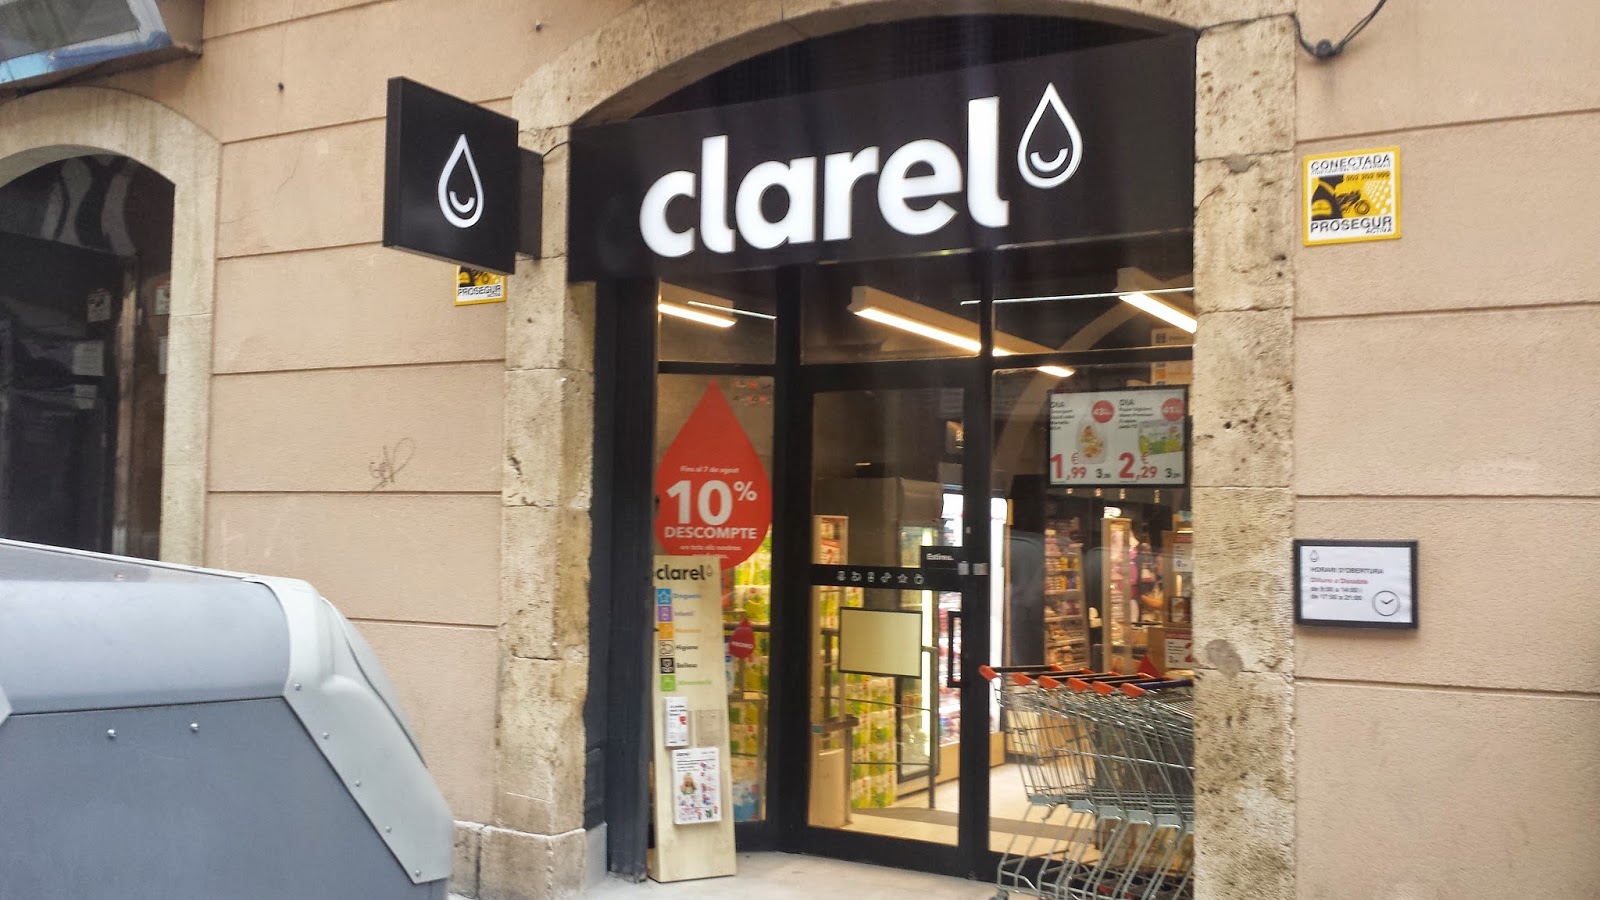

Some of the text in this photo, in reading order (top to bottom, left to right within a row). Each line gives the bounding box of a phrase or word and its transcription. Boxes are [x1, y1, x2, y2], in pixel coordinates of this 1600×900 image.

[1311, 154, 1390, 170] CONECTADA
[640, 95, 1009, 257] clarel
[1311, 216, 1392, 233] PROSEGUR
[457, 285, 501, 296] PROSEGUR
[666, 480, 757, 526] 10%
[664, 526, 758, 539] DESCOMPTE
[656, 564, 705, 580] clarel
